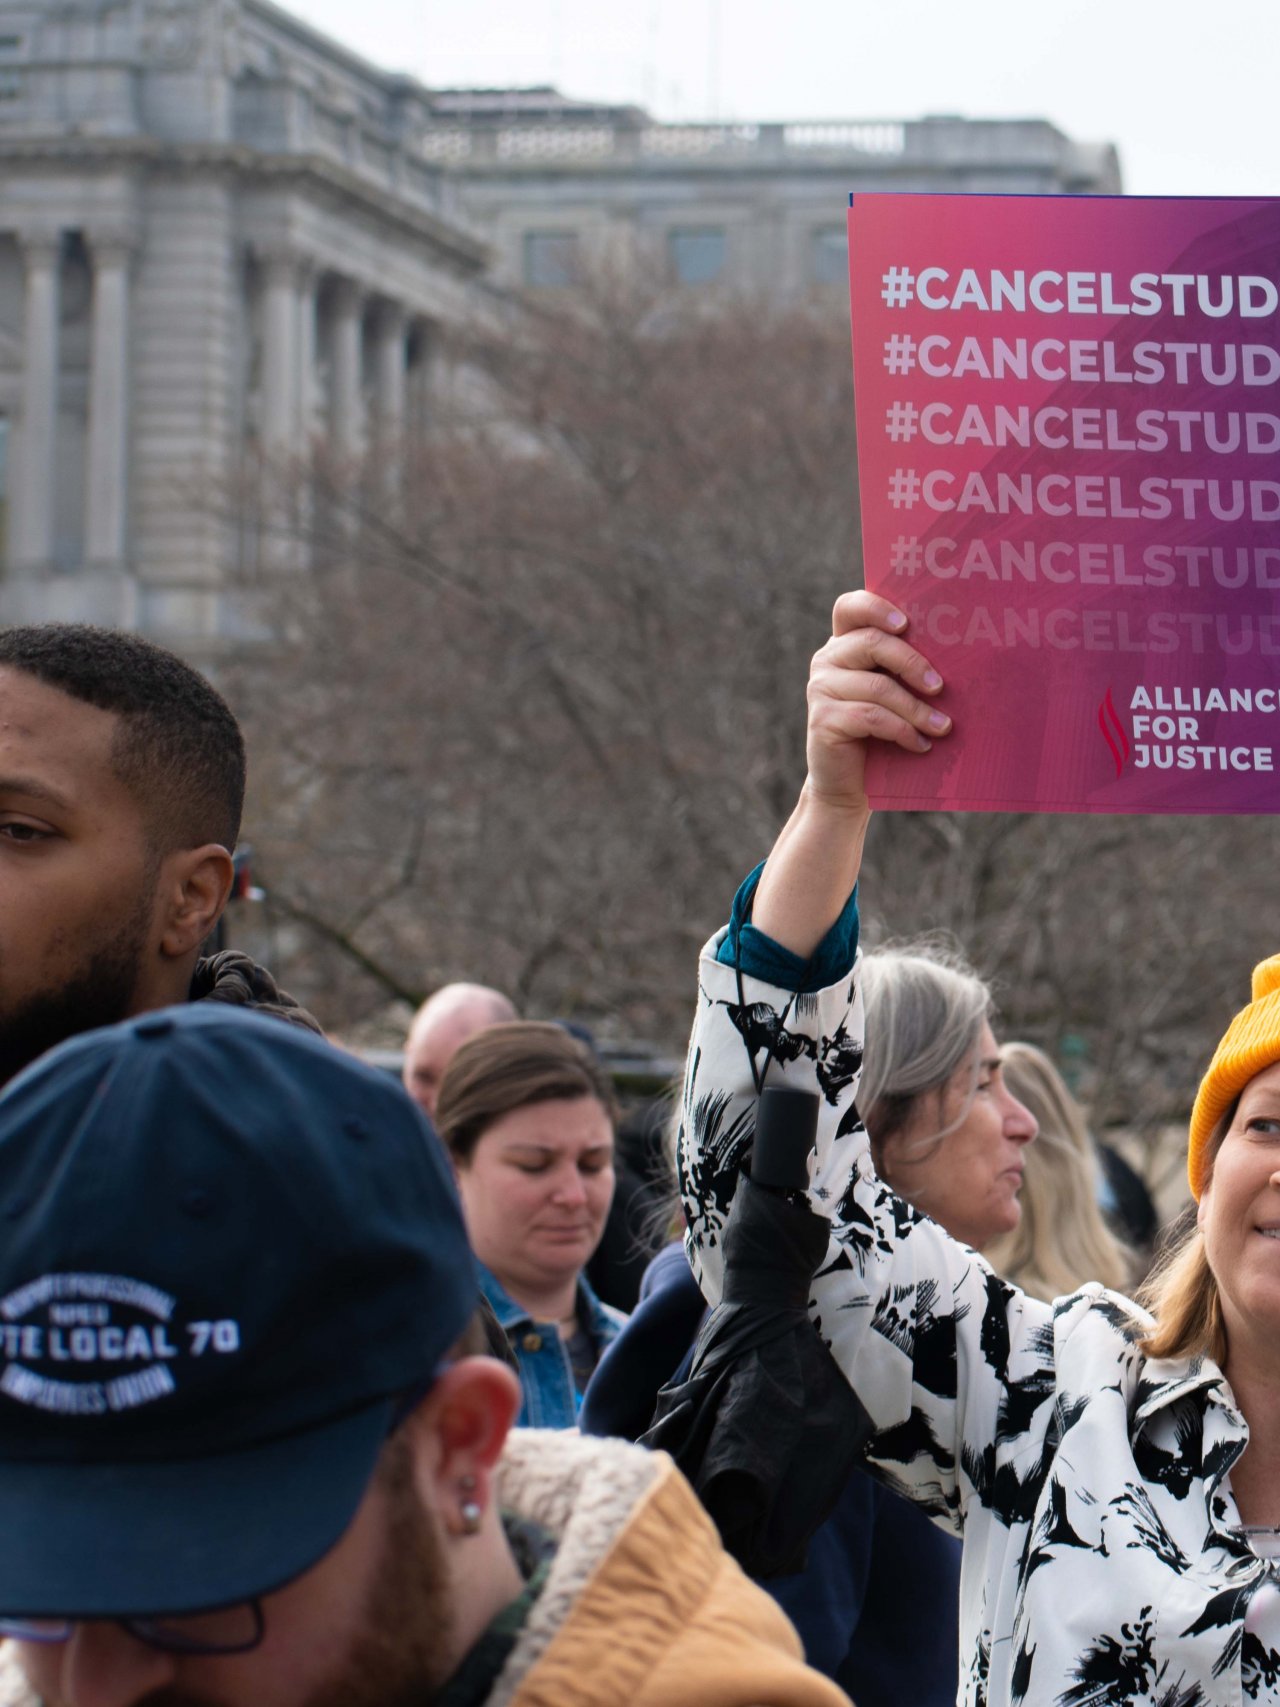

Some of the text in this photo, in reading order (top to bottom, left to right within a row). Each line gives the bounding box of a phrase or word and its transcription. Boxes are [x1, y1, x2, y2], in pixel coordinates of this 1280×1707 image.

[1132, 715, 1200, 740] FOR
[1134, 744, 1274, 771] JUSTICE
[0, 1318, 240, 1361] TE LOCAL 70
